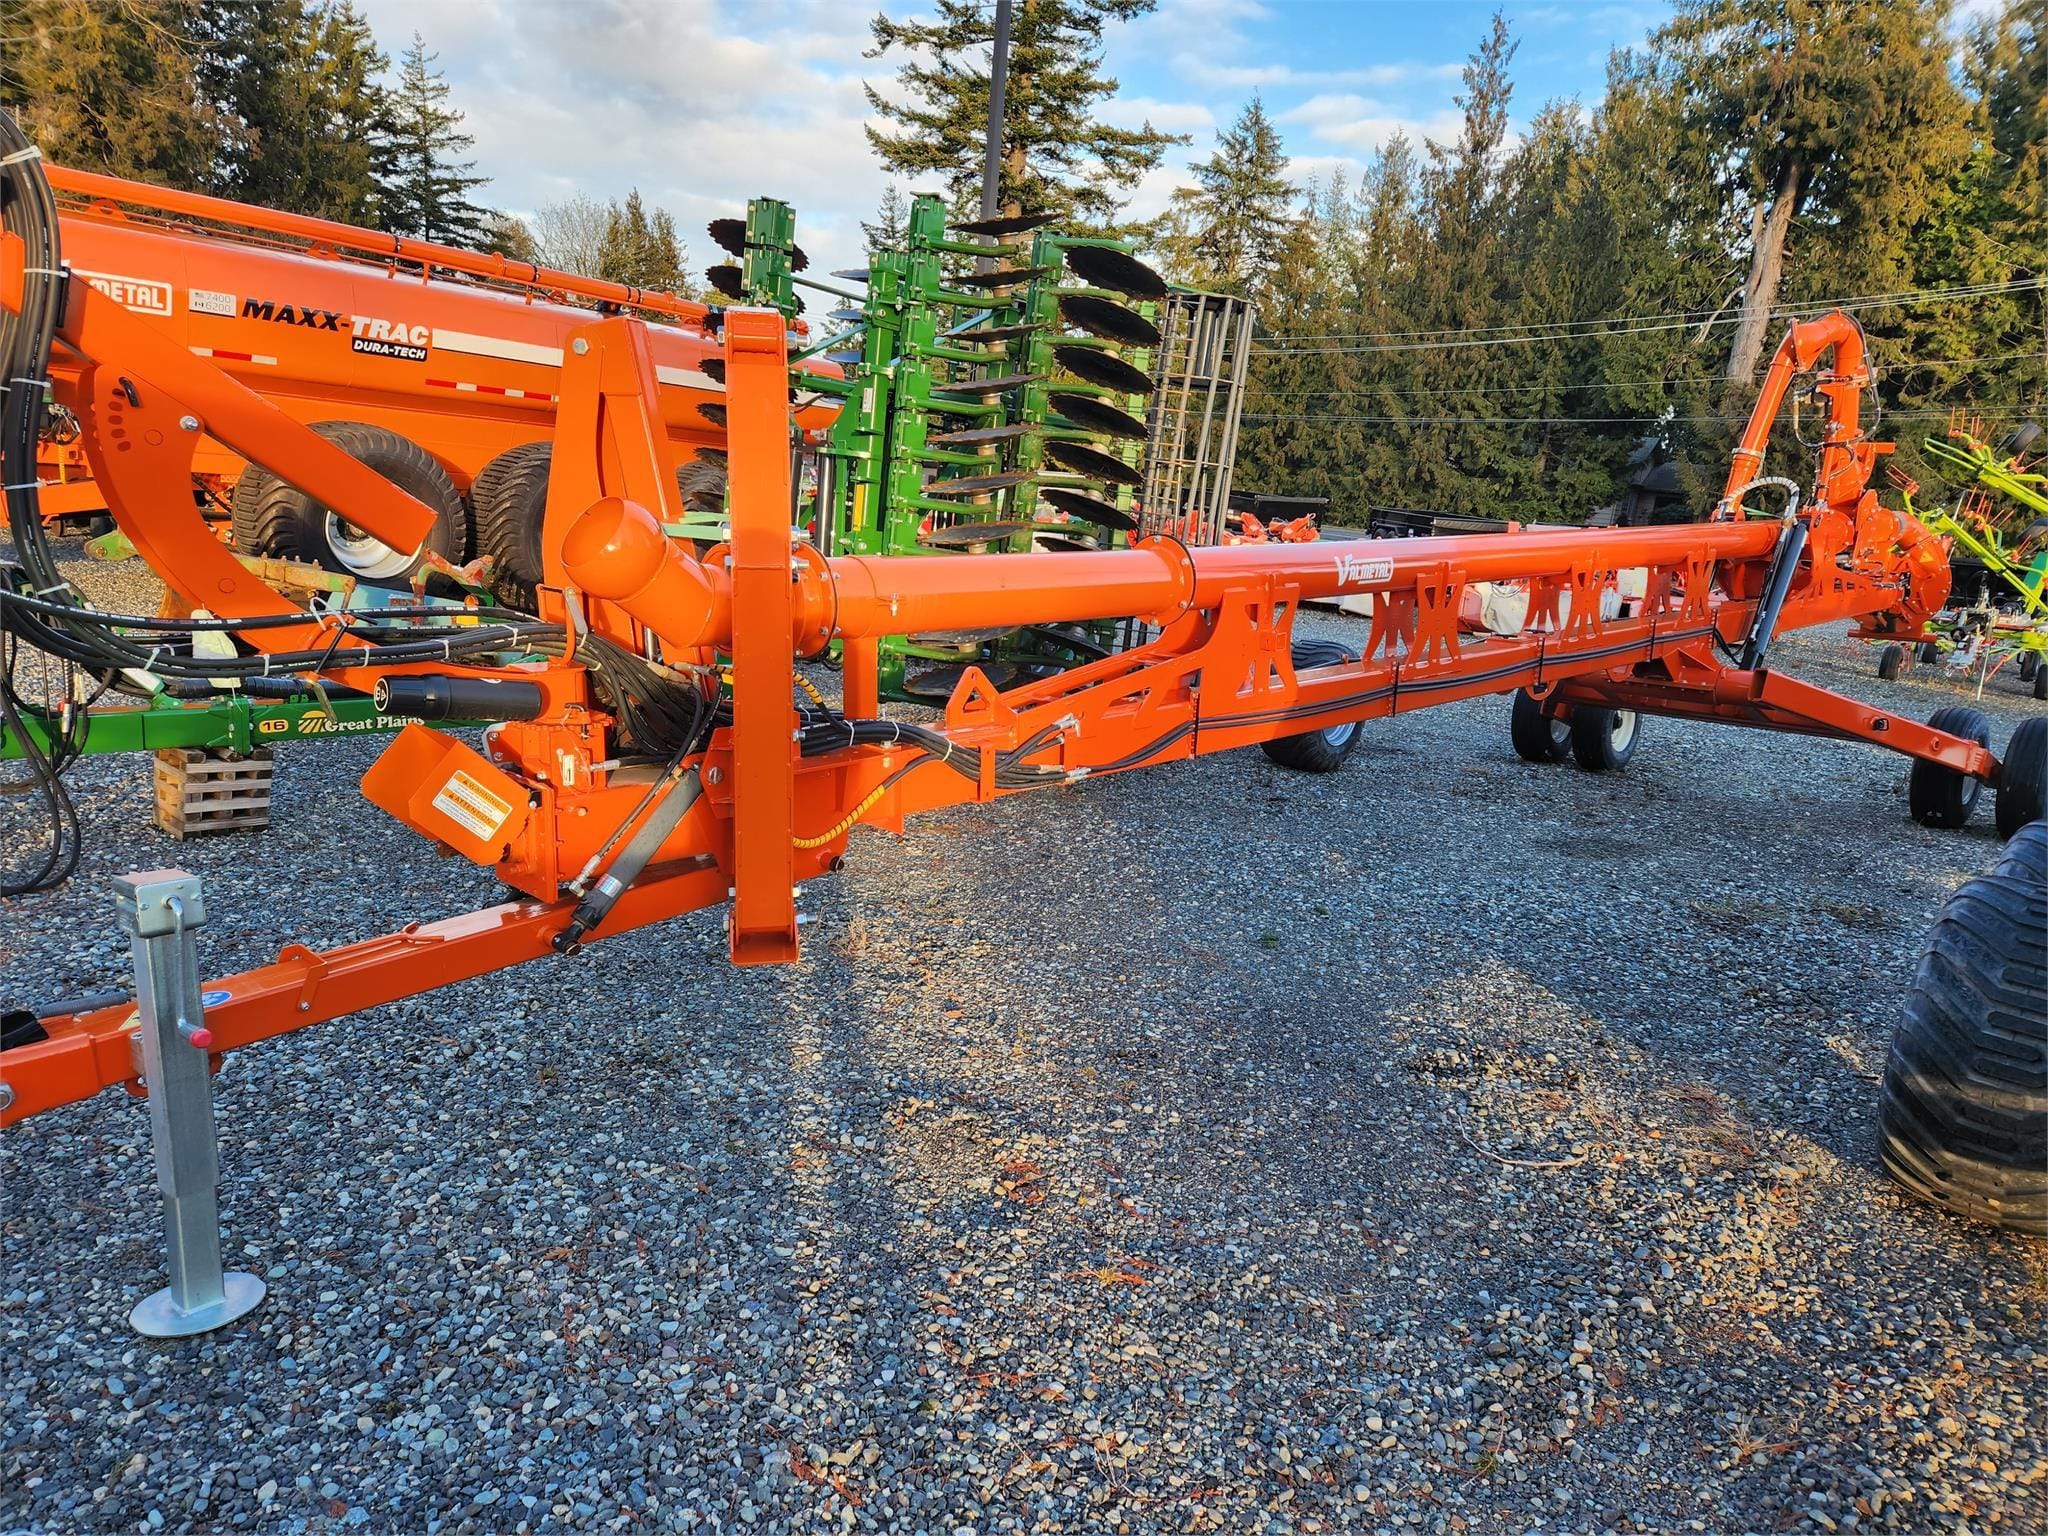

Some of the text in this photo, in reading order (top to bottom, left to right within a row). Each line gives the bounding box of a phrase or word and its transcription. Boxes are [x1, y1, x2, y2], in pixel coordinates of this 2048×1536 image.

[206, 293, 231, 303] 7400
[205, 301, 231, 312] 6200
[242, 298, 429, 346] MAXX-TRAC
[354, 339, 426, 360] DURA-TECH
[262, 721, 285, 731] 16
[324, 718, 373, 732] Great
